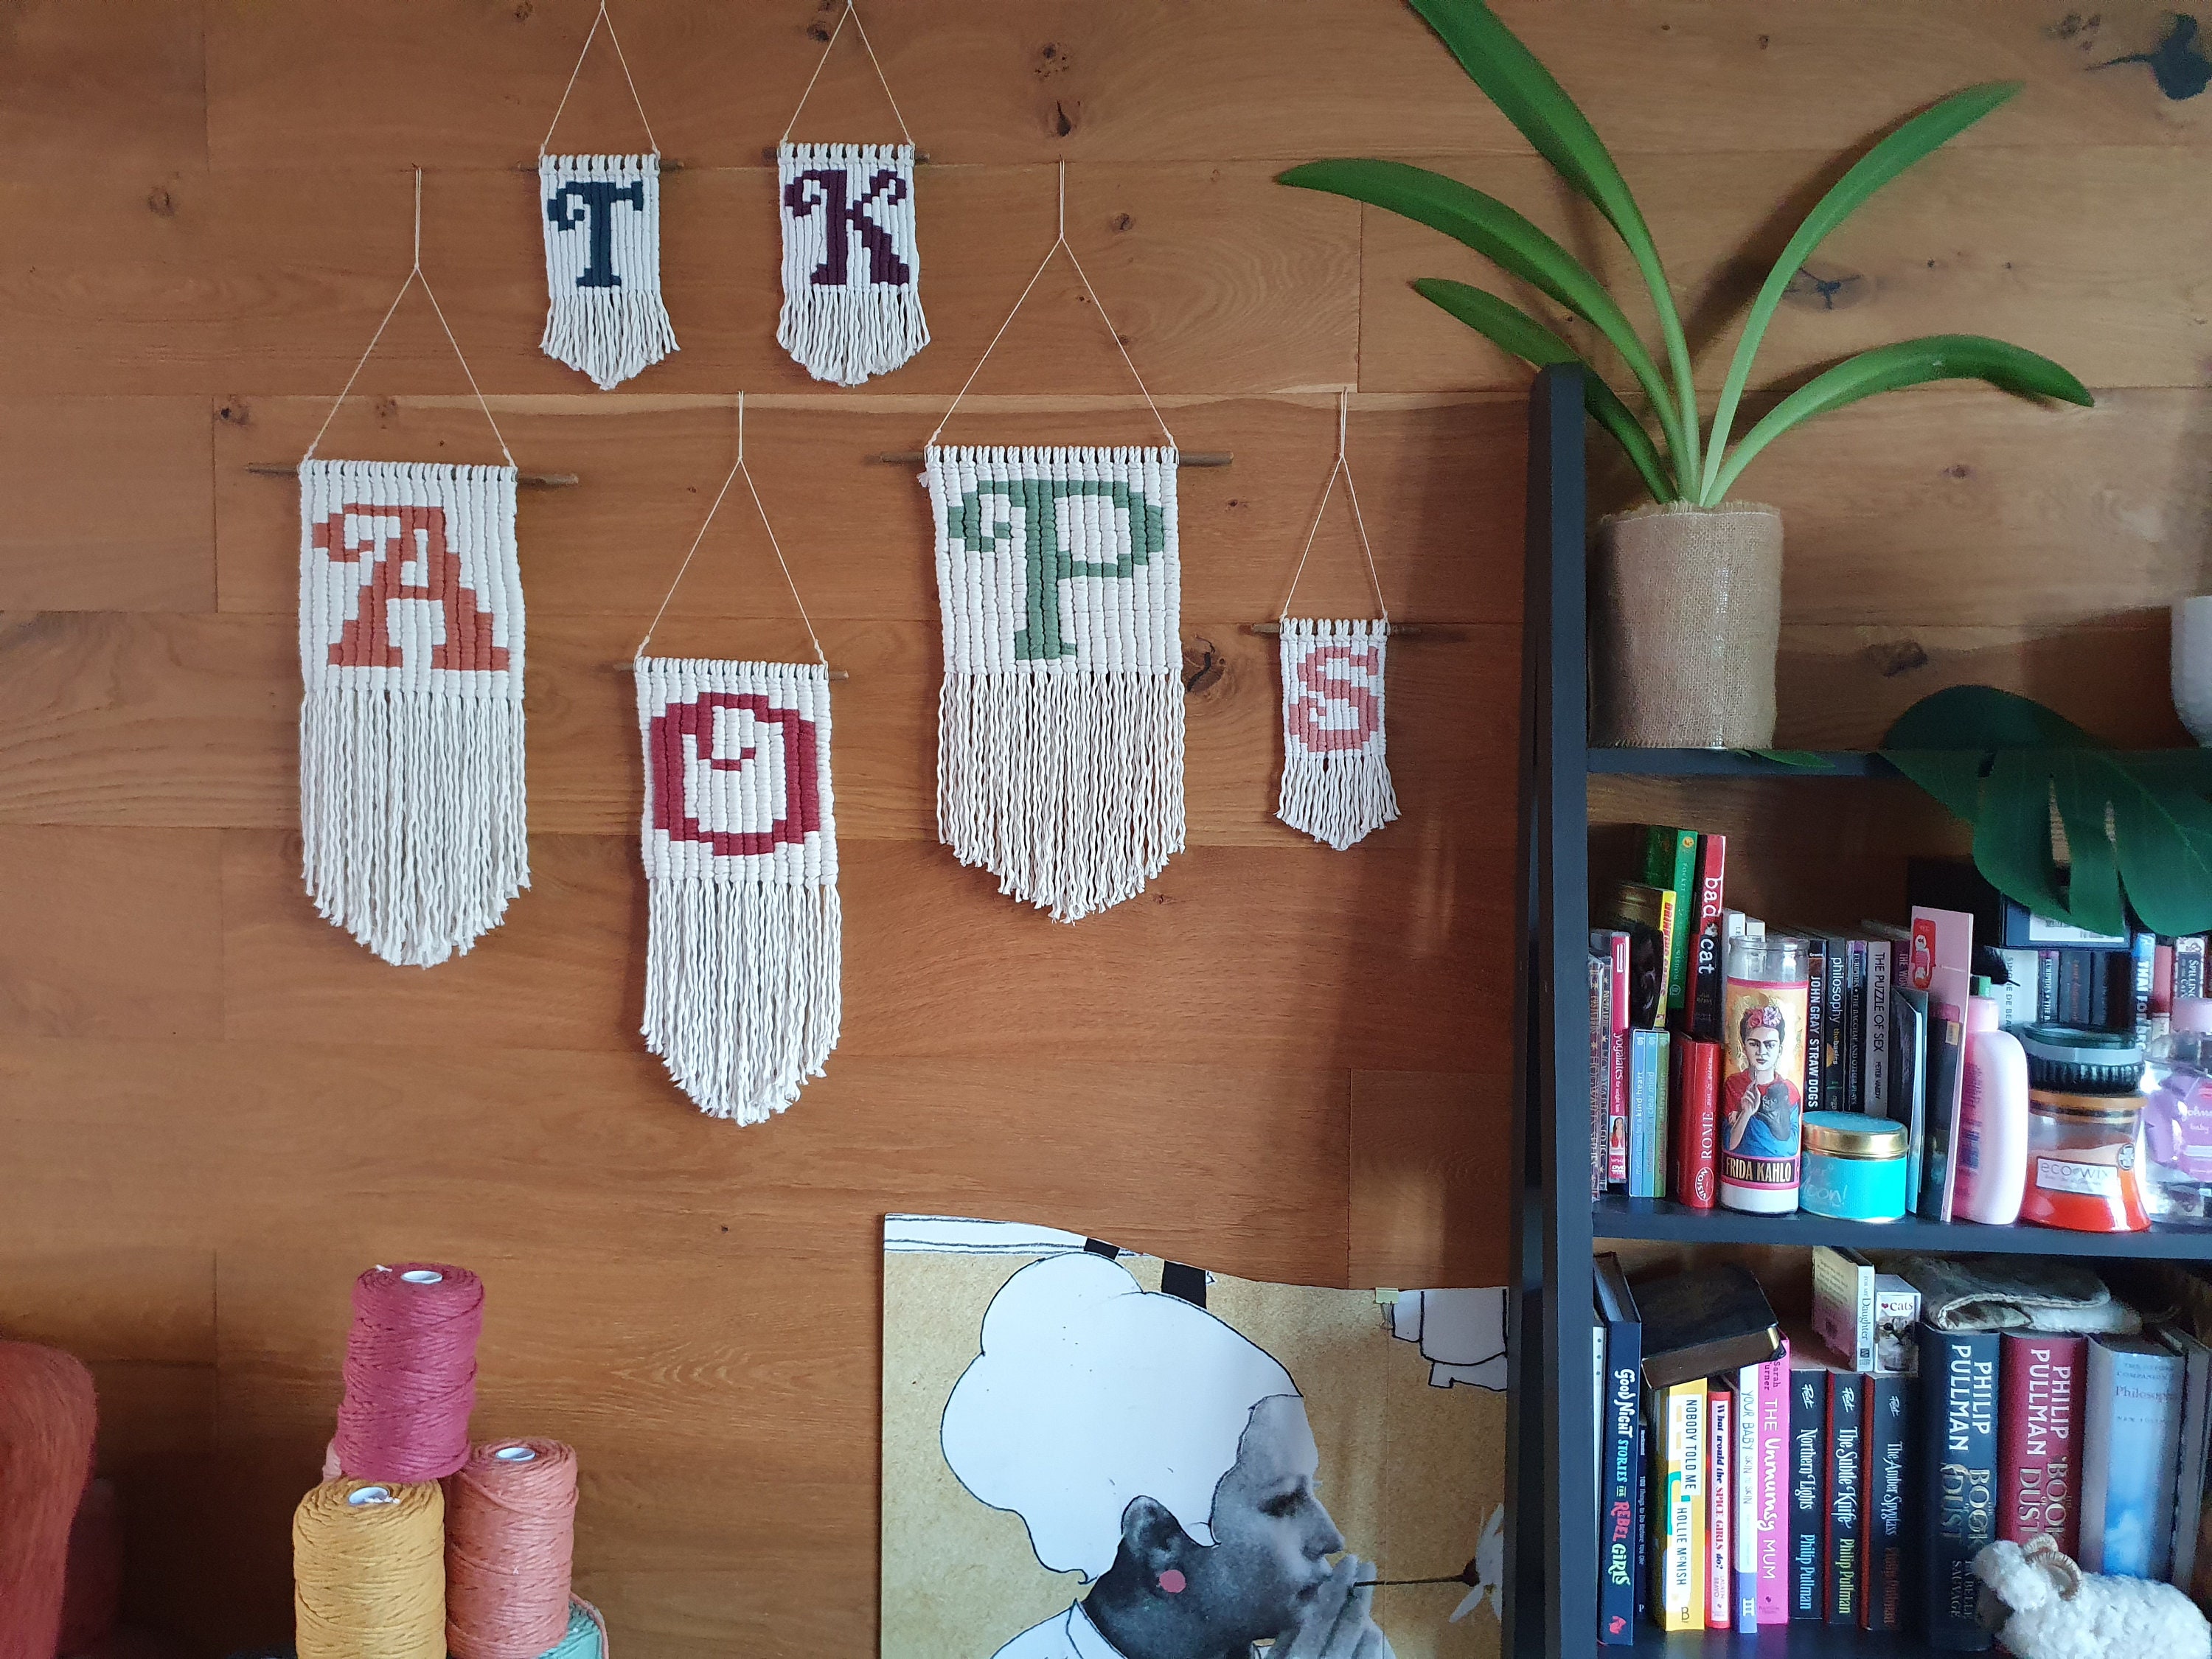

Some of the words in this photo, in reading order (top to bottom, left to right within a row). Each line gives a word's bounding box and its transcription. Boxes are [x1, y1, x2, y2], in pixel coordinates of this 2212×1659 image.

[548, 181, 644, 288] T
[785, 170, 910, 286] K
[313, 504, 510, 671] A
[948, 479, 1164, 661] P
[1290, 645, 1380, 753] S
[1703, 877, 1722, 918] bad
[1698, 938, 1715, 975] cat
[1875, 952, 1885, 971] THE
[1810, 975, 1820, 1003] JOHN
[1829, 957, 1844, 1023] philosophy
[1874, 975, 1884, 1011] PUZZLE
[2006, 994, 2013, 1005] DE
[1809, 1006, 1820, 1034] GRAY
[1874, 1015, 1884, 1029] OF
[1613, 1032, 1627, 1080] yogalates
[1809, 1038, 1819, 1077] STRAW
[1874, 1033, 1883, 1052] SEX
[1635, 1071, 1644, 1095] heart
[1646, 1071, 1655, 1092] mind
[1808, 1079, 1818, 1107] DOGS
[1634, 1097, 1643, 1117] kind
[1646, 1096, 1654, 1115] clear
[1701, 1111, 1714, 1160] ROME
[1697, 1169, 1707, 1200] VISION
[1726, 1158, 1753, 1178] FRIDA
[1756, 1161, 1792, 1183] KAHLO
[1859, 1298, 1871, 1340] Daughter
[1890, 1301, 1913, 1312] cats
[1742, 1390, 1753, 1416] YOUR
[1764, 1398, 1778, 1432] THE
[1948, 1344, 1972, 1452] PULLMAN
[1972, 1361, 1992, 1435] PHILIP
[2026, 1348, 2051, 1456] PULLMAN
[2050, 1366, 2071, 1439] PHILIP
[1686, 1399, 1697, 1441] NOBODY
[1716, 1403, 1726, 1431] What
[1716, 1435, 1725, 1466] would
[1742, 1422, 1753, 1451] BABY
[1796, 1427, 1818, 1474] Northern
[1838, 1426, 1858, 1449] The
[1887, 1441, 1903, 1460] The
[1615, 1439, 1629, 1482] STORIES
[1686, 1444, 1697, 1471] TOLD
[1742, 1455, 1752, 1475] SKIN
[1836, 1448, 1857, 1485] Subtle
[1882, 1457, 1902, 1493] Amber
[1685, 1475, 1697, 1490] ME
[1716, 1468, 1725, 1484] the
[1757, 1437, 1781, 1531] Unmumsy
[1795, 1475, 1816, 1510] Lights
[1638, 1488, 1646, 1506] Things
[1716, 1487, 1724, 1517] SPICE
[1743, 1486, 1753, 1504] SKIN
[1831, 1486, 1857, 1529] Knife
[1939, 1475, 1964, 1543] DUST
[1967, 1469, 1990, 1551] BOOK
[2018, 1467, 2042, 1534] DUST
[1610, 1500, 1631, 1542] REBEL
[1677, 1508, 1688, 1543] HOLLIE
[1881, 1494, 1902, 1537] Spyglass
[1716, 1520, 1724, 1551] GIRLS
[1795, 1534, 1815, 1564] Philip
[1715, 1553, 1724, 1570] do?
[1763, 1539, 1776, 1580] MUM
[1835, 1538, 1854, 1569] Philip
[1799, 1567, 1815, 1610] Pullman
[1838, 1570, 1854, 1614] Pullman
